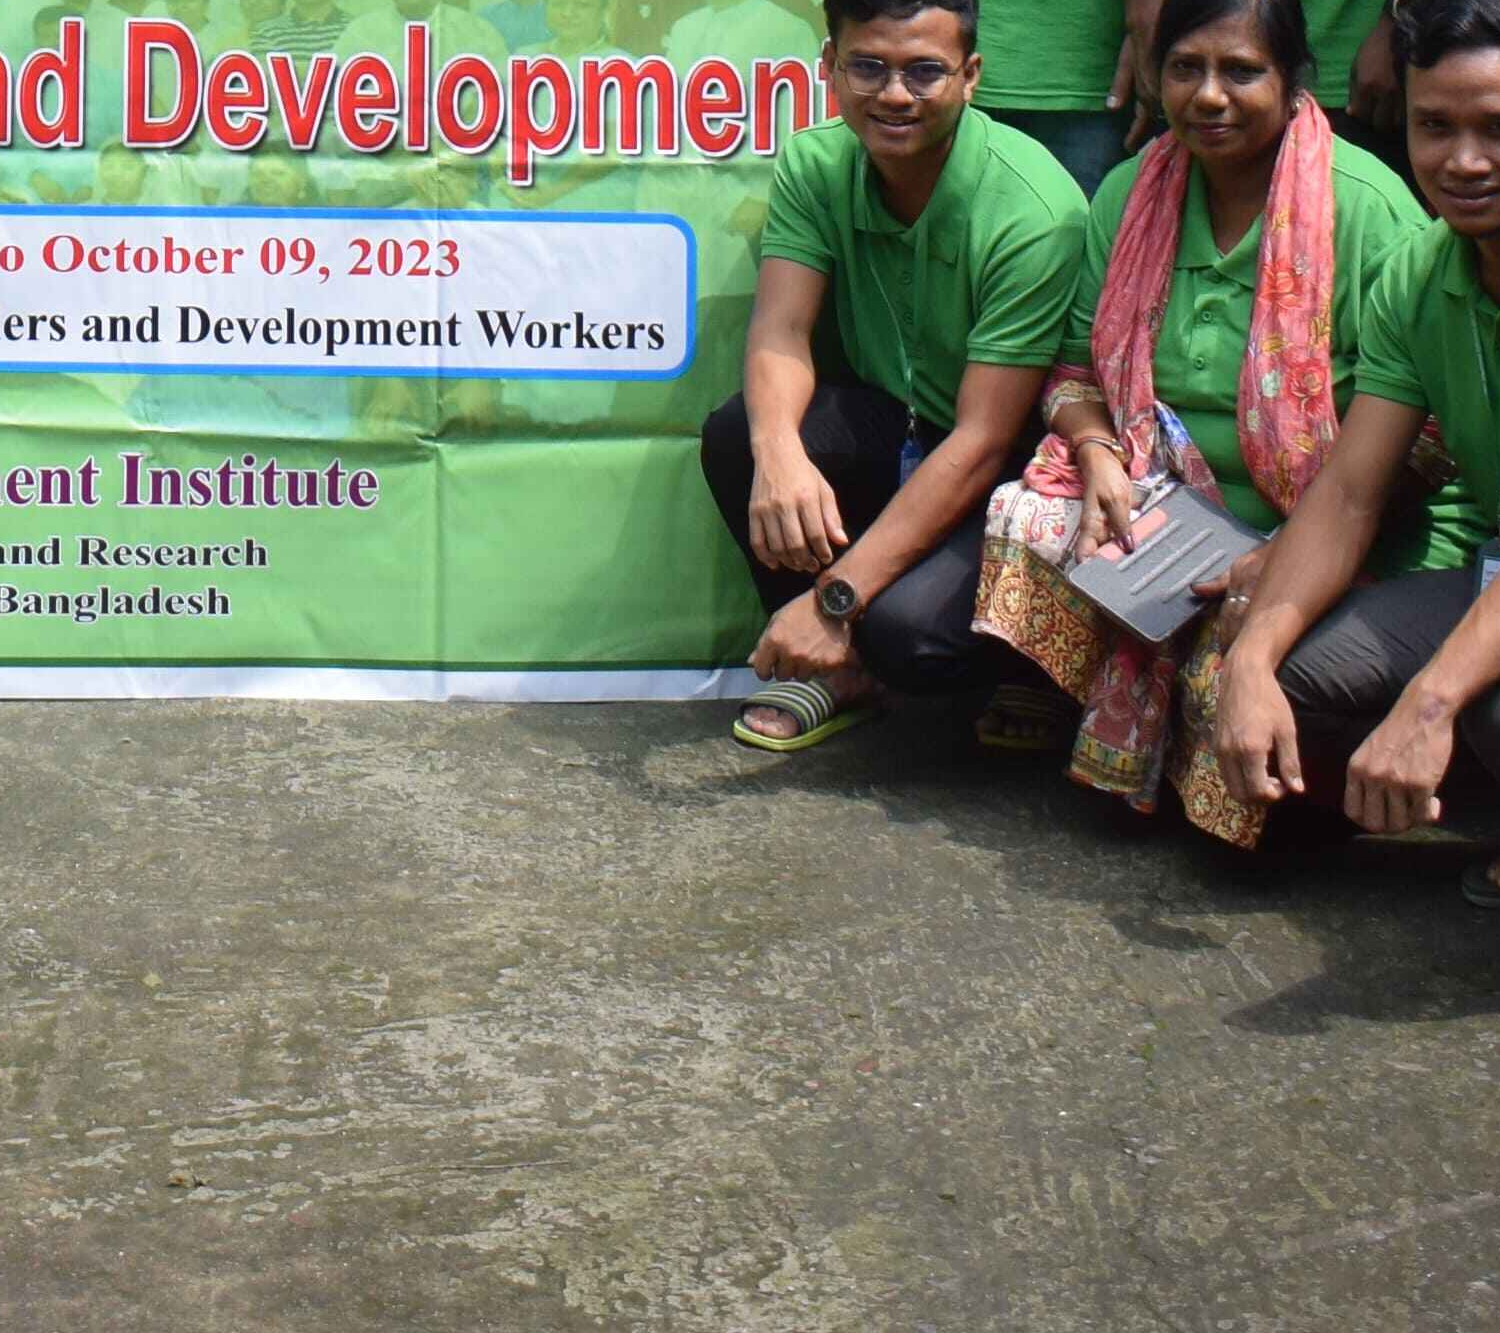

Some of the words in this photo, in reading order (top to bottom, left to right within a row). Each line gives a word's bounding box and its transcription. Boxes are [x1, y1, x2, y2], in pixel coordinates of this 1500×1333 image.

[42, 235, 243, 276] October
[258, 238, 330, 284] 09,
[349, 237, 463, 278] 2023
[81, 305, 160, 344] and
[178, 305, 462, 357] Development
[475, 307, 666, 351] Workers
[120, 453, 379, 509] Institute
[78, 537, 269, 568] Research
